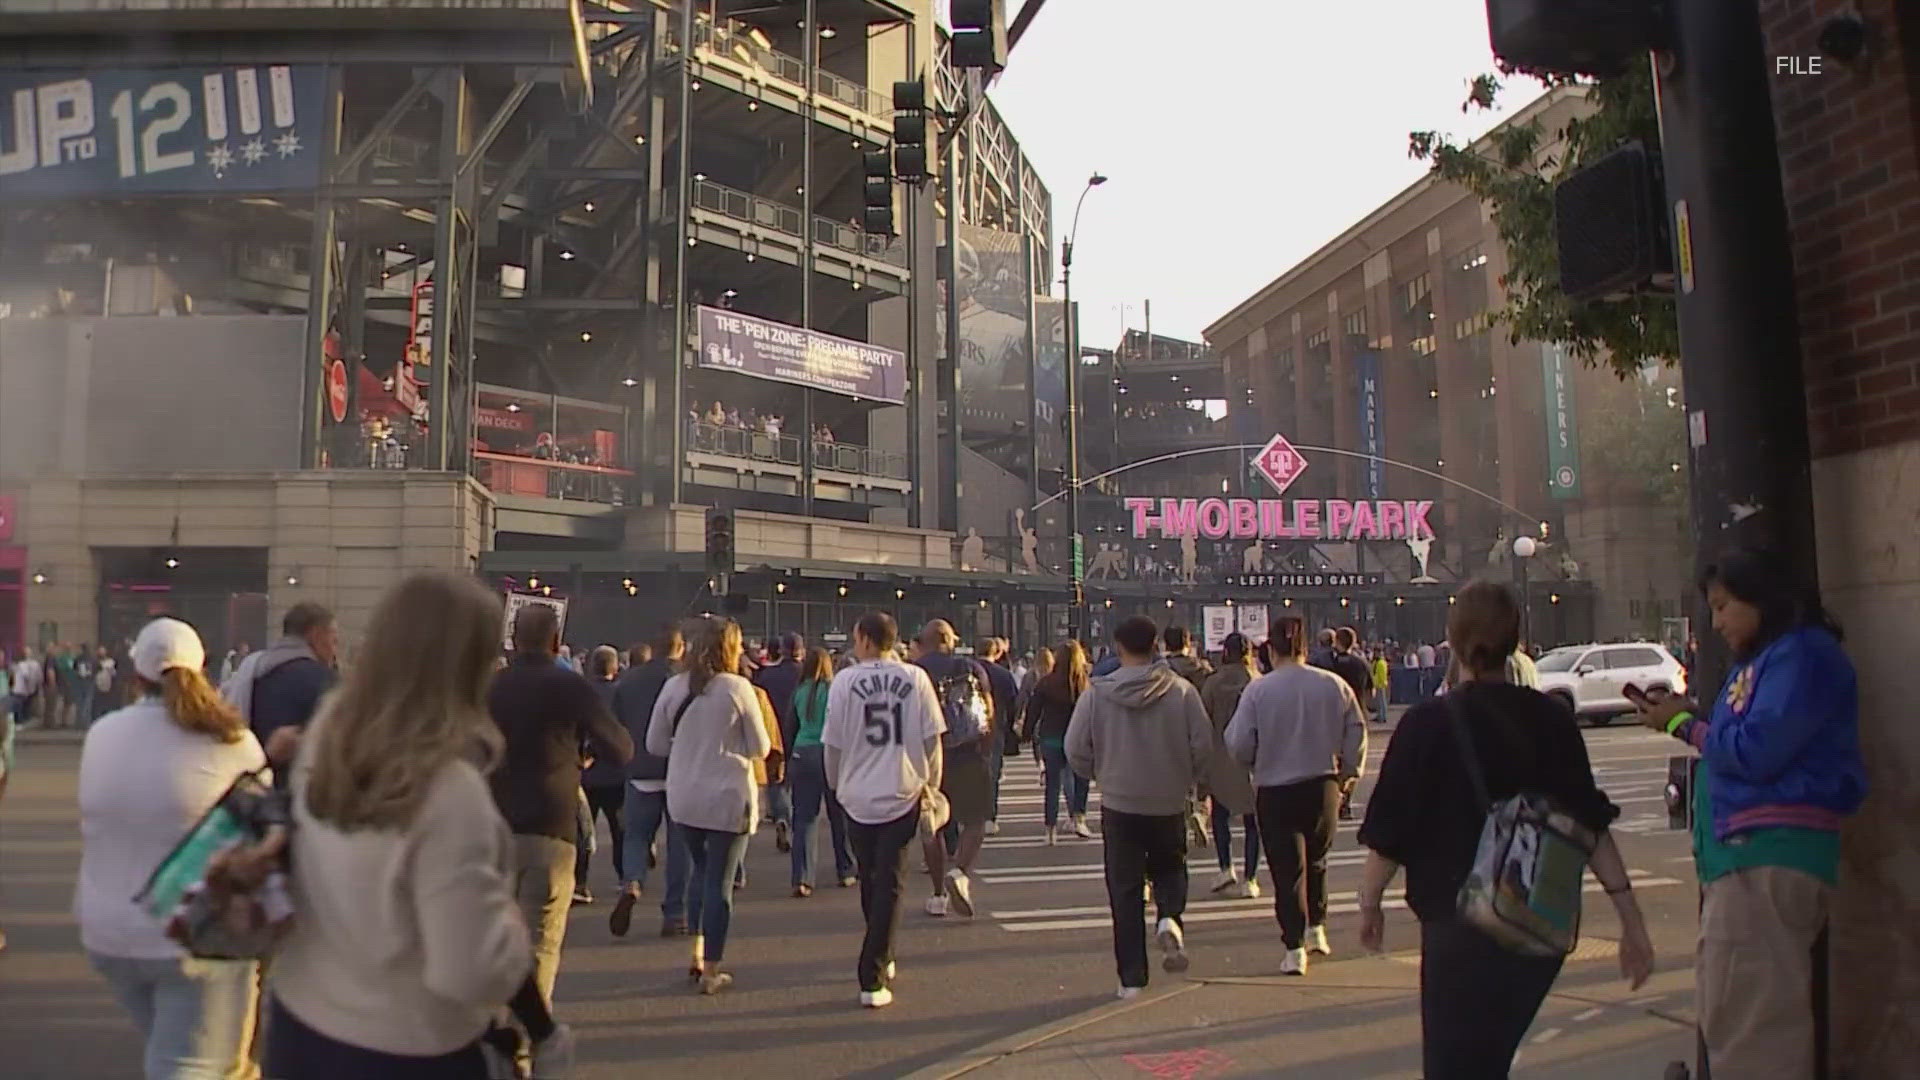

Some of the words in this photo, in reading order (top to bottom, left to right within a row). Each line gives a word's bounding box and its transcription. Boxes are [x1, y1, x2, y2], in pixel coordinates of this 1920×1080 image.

[715, 315, 742, 335] THE
[806, 335, 860, 361] PREGAME
[859, 347, 894, 368] PARTY
[1363, 379, 1379, 499] MARINERS
[1124, 497, 1321, 540] T-MOBILE
[1325, 500, 1435, 540] PARK
[1239, 574, 1274, 586] LEFT
[1281, 575, 1323, 586] FIELD
[1329, 575, 1366, 586] GATE
[850, 673, 913, 701] ICHIRO
[864, 702, 904, 747] 51
